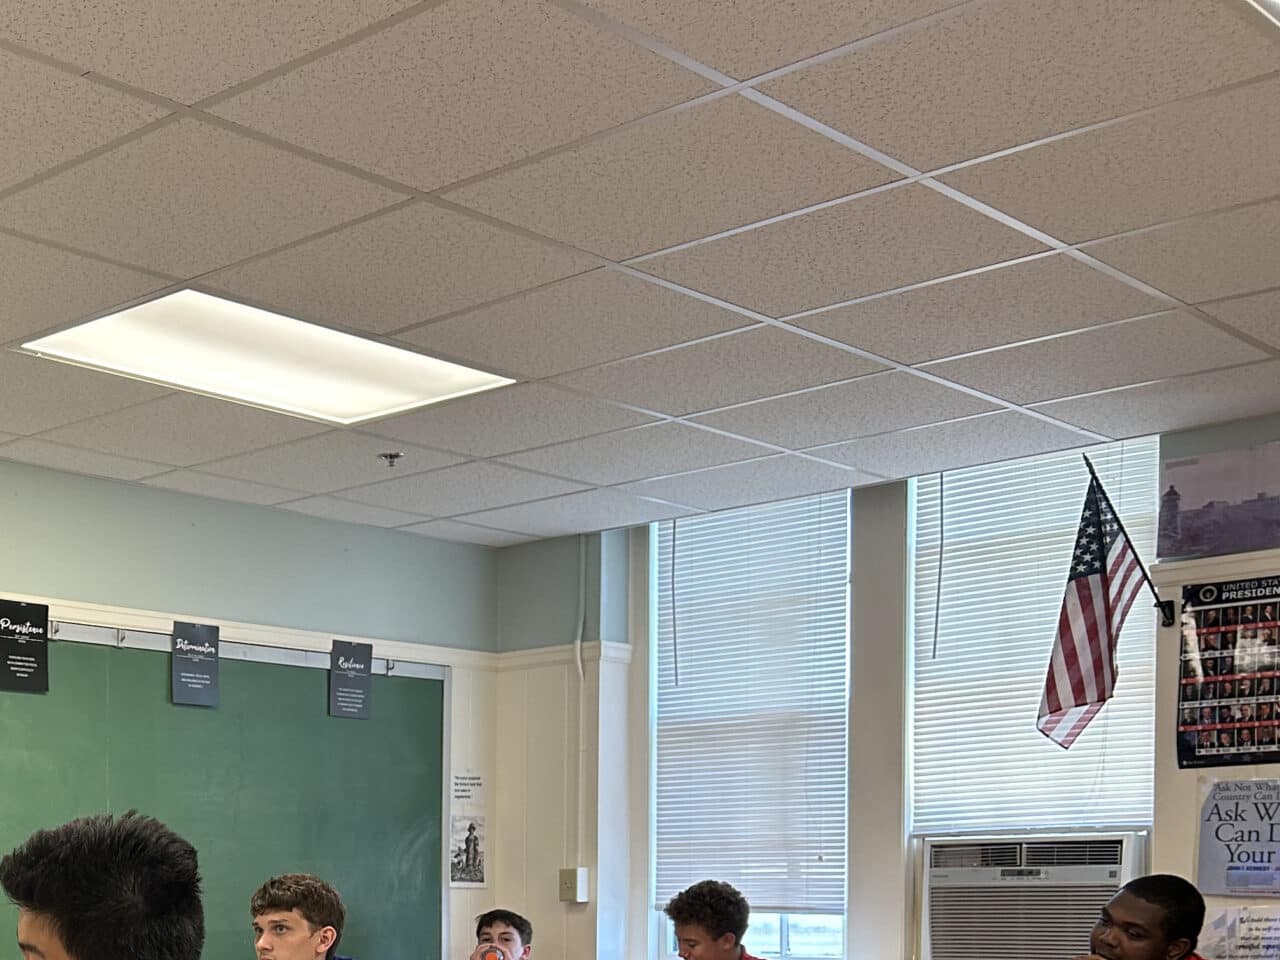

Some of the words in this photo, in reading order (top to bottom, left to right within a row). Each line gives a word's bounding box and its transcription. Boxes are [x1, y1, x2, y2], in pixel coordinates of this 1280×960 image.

[1222, 581, 1258, 591] UNITED
[1261, 577, 1280, 588] STA
[1234, 783, 1251, 792] Not
[1253, 791, 1273, 801] Can
[1205, 802, 1248, 822] Ask
[1214, 822, 1261, 843] Can
[1224, 843, 1277, 864] Your
